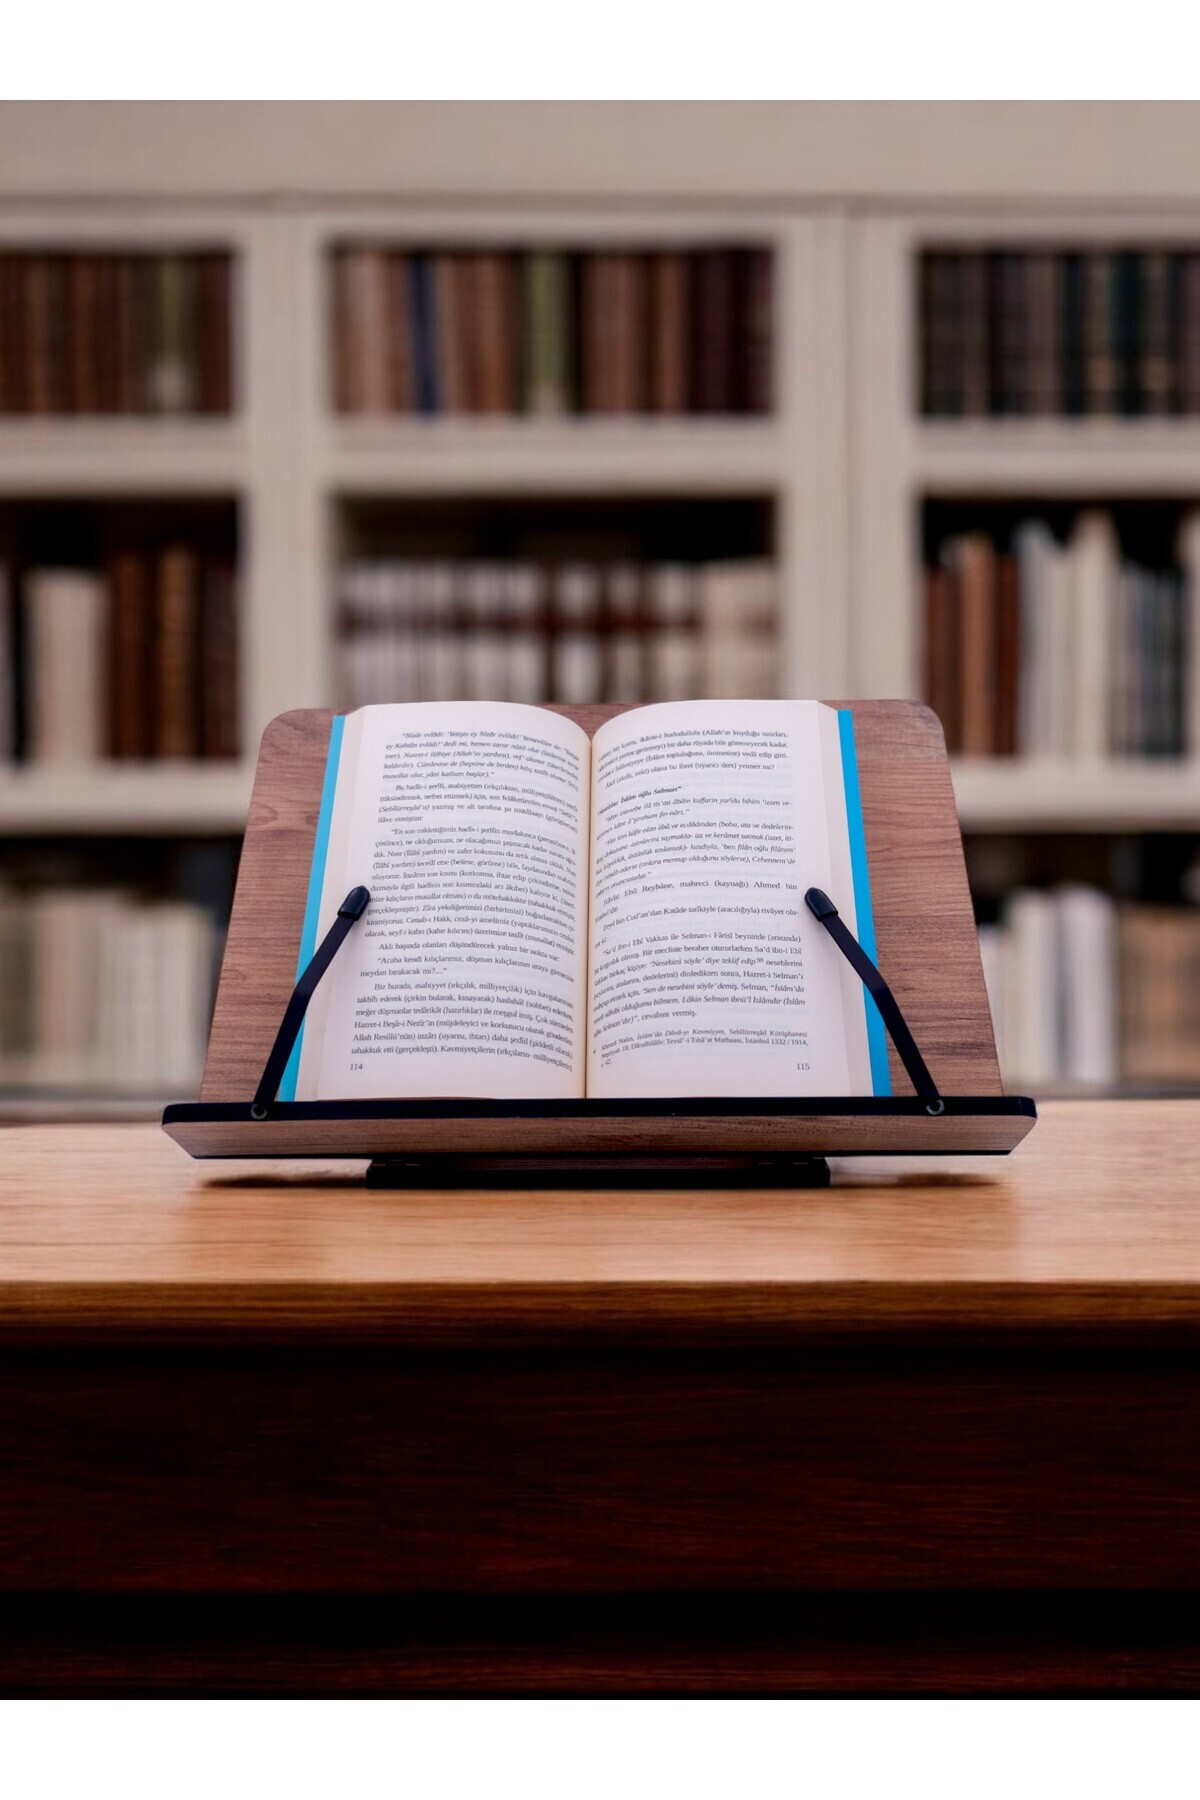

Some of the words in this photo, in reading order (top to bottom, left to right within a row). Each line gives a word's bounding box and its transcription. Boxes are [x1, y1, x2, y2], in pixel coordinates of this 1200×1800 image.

[496, 762, 519, 770] birden)
[474, 929, 507, 937] üzerimize
[767, 934, 801, 943] (arasında)
